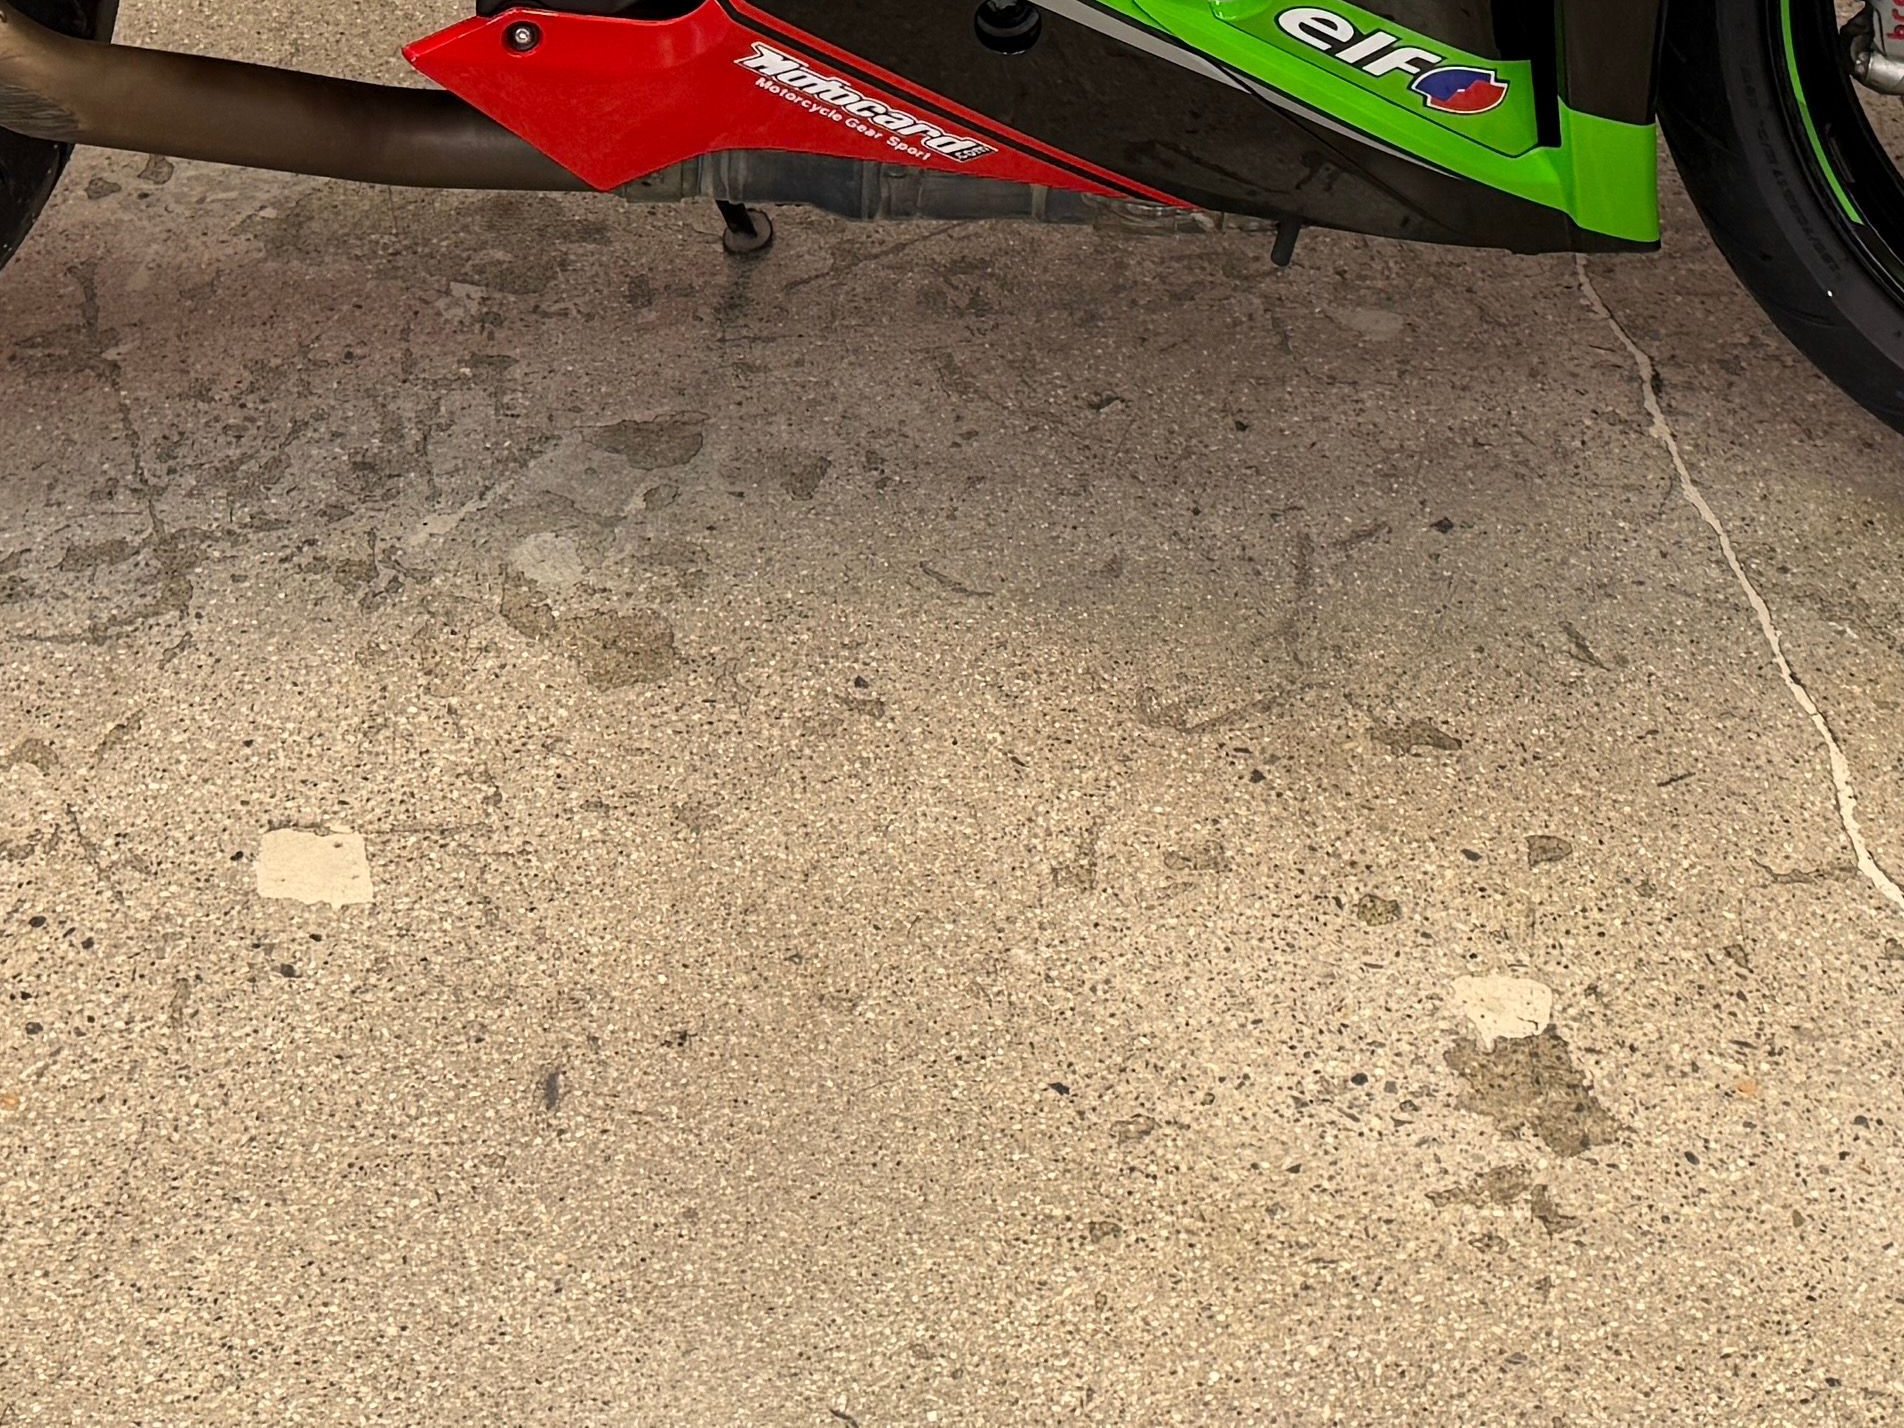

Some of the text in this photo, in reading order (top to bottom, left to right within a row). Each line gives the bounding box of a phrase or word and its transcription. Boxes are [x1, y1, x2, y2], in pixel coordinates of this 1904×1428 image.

[1276, 7, 1444, 78] elf
[737, 42, 972, 158] Motocard
[754, 76, 933, 162] Motorcycle Gear Sport
